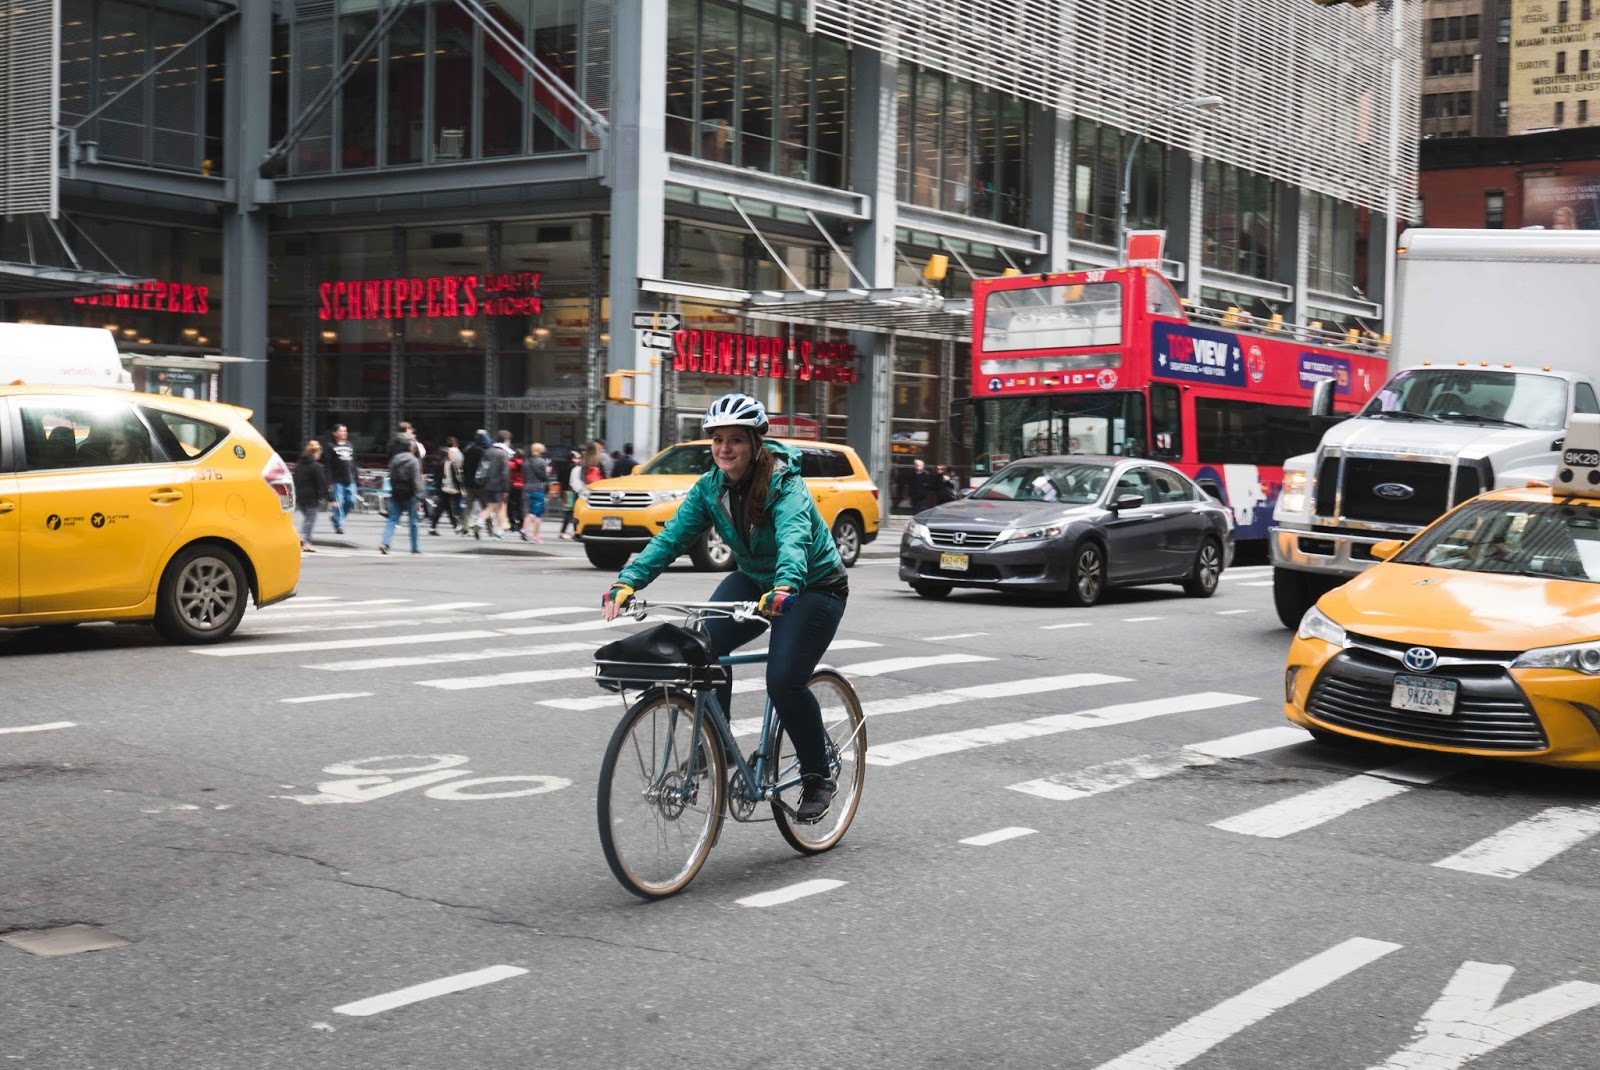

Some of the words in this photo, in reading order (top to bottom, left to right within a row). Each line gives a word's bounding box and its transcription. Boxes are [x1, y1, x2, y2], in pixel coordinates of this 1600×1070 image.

[1520, 14, 1549, 24] VEGAS
[1516, 60, 1550, 70] EUROPE
[1533, 85, 1571, 96] MIDDLE
[1085, 270, 1107, 283] 307
[319, 275, 479, 321] SCHNIPPER'S
[483, 272, 542, 293] QUALITY
[483, 296, 542, 316] KITCHEN
[1565, 451, 1599, 465] 9K28
[1381, 485, 1407, 497] Ford
